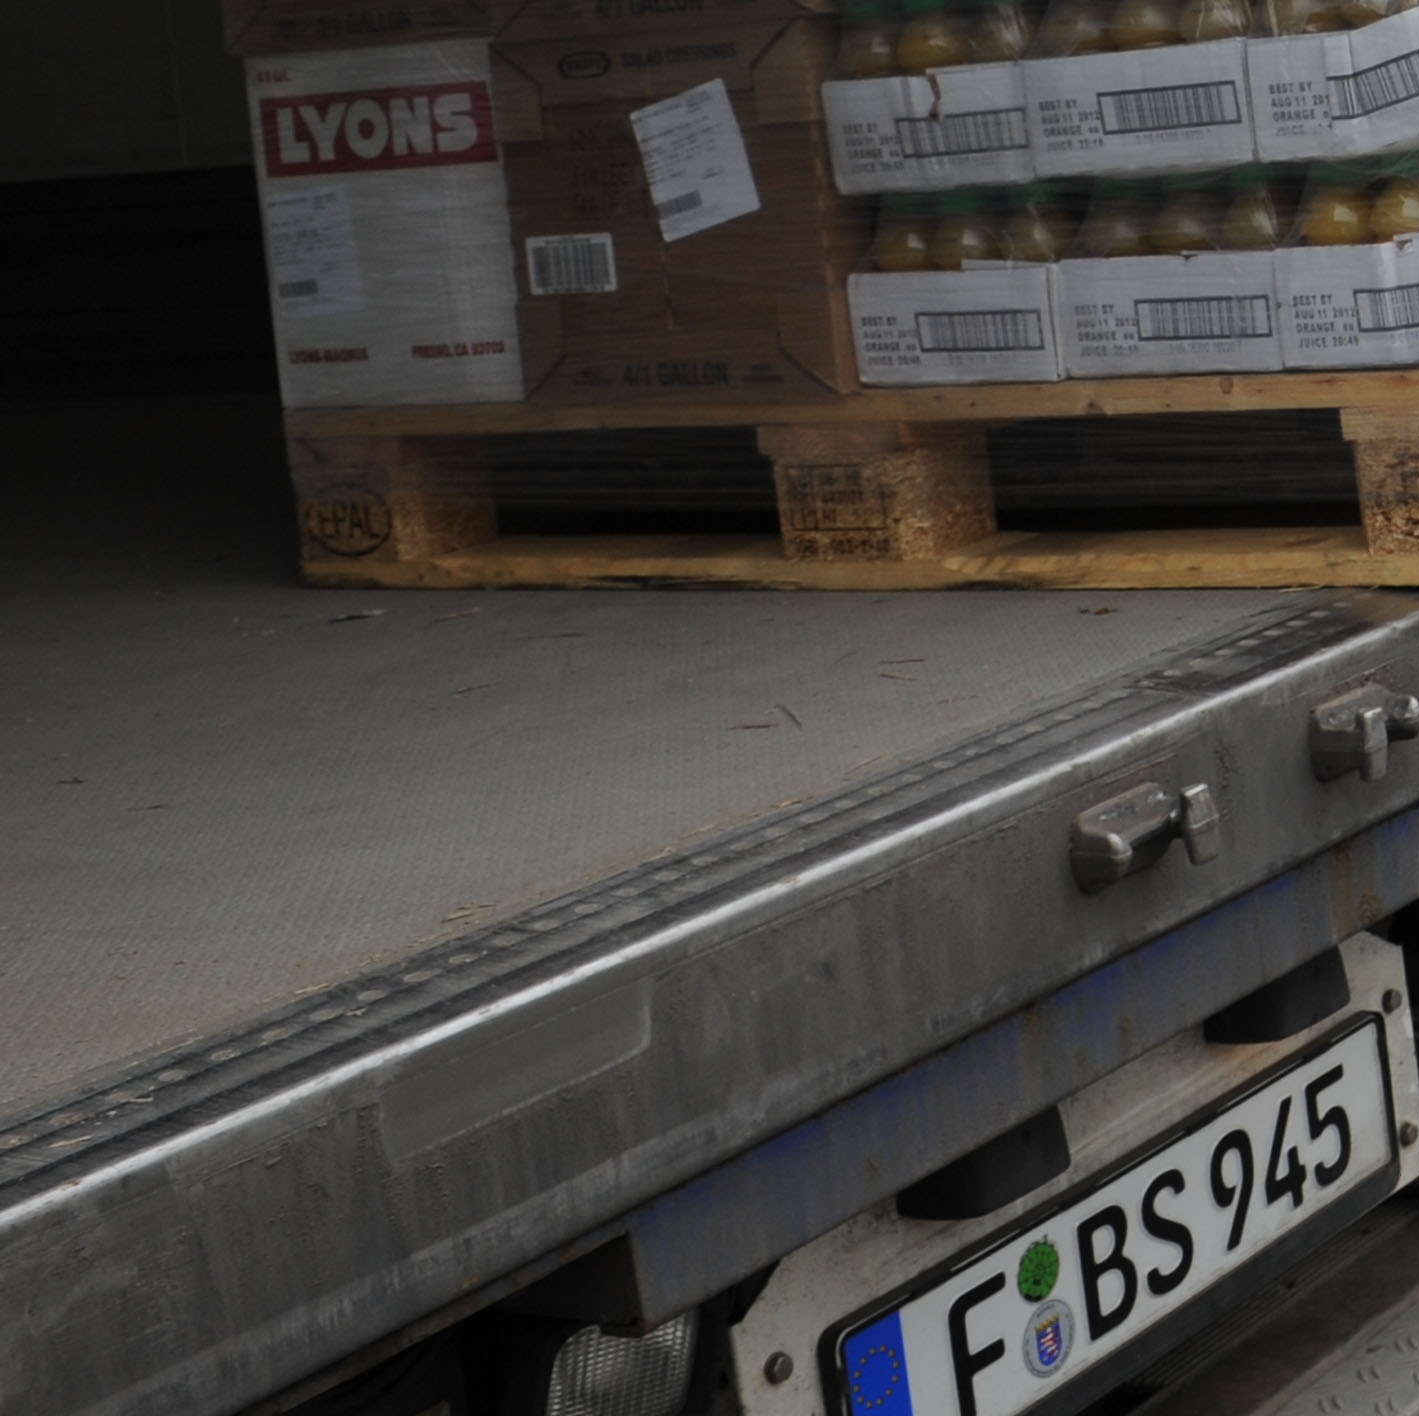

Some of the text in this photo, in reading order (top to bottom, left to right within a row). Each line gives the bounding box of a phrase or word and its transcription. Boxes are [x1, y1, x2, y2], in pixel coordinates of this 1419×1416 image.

[1269, 81, 1312, 95] BEST BY
[1271, 95, 1292, 109] AUG
[1041, 114, 1060, 125] AUG
[1078, 110, 1101, 122] 2012
[1272, 108, 1316, 123] ORANGE
[275, 92, 478, 165] LYONS
[1043, 125, 1083, 138] ORANGE
[1292, 293, 1333, 308] BEST BY
[1294, 306, 1358, 320] AUG 11 2012
[1296, 322, 1336, 335] ORANGE
[1077, 330, 1116, 342] ORANGE
[1298, 336, 1328, 350] JUICE
[864, 341, 900, 352] ORANGE
[655, 361, 729, 389] GALLON
[317, 500, 382, 540] EPAL
[948, 1063, 1352, 1416] F BS 945
